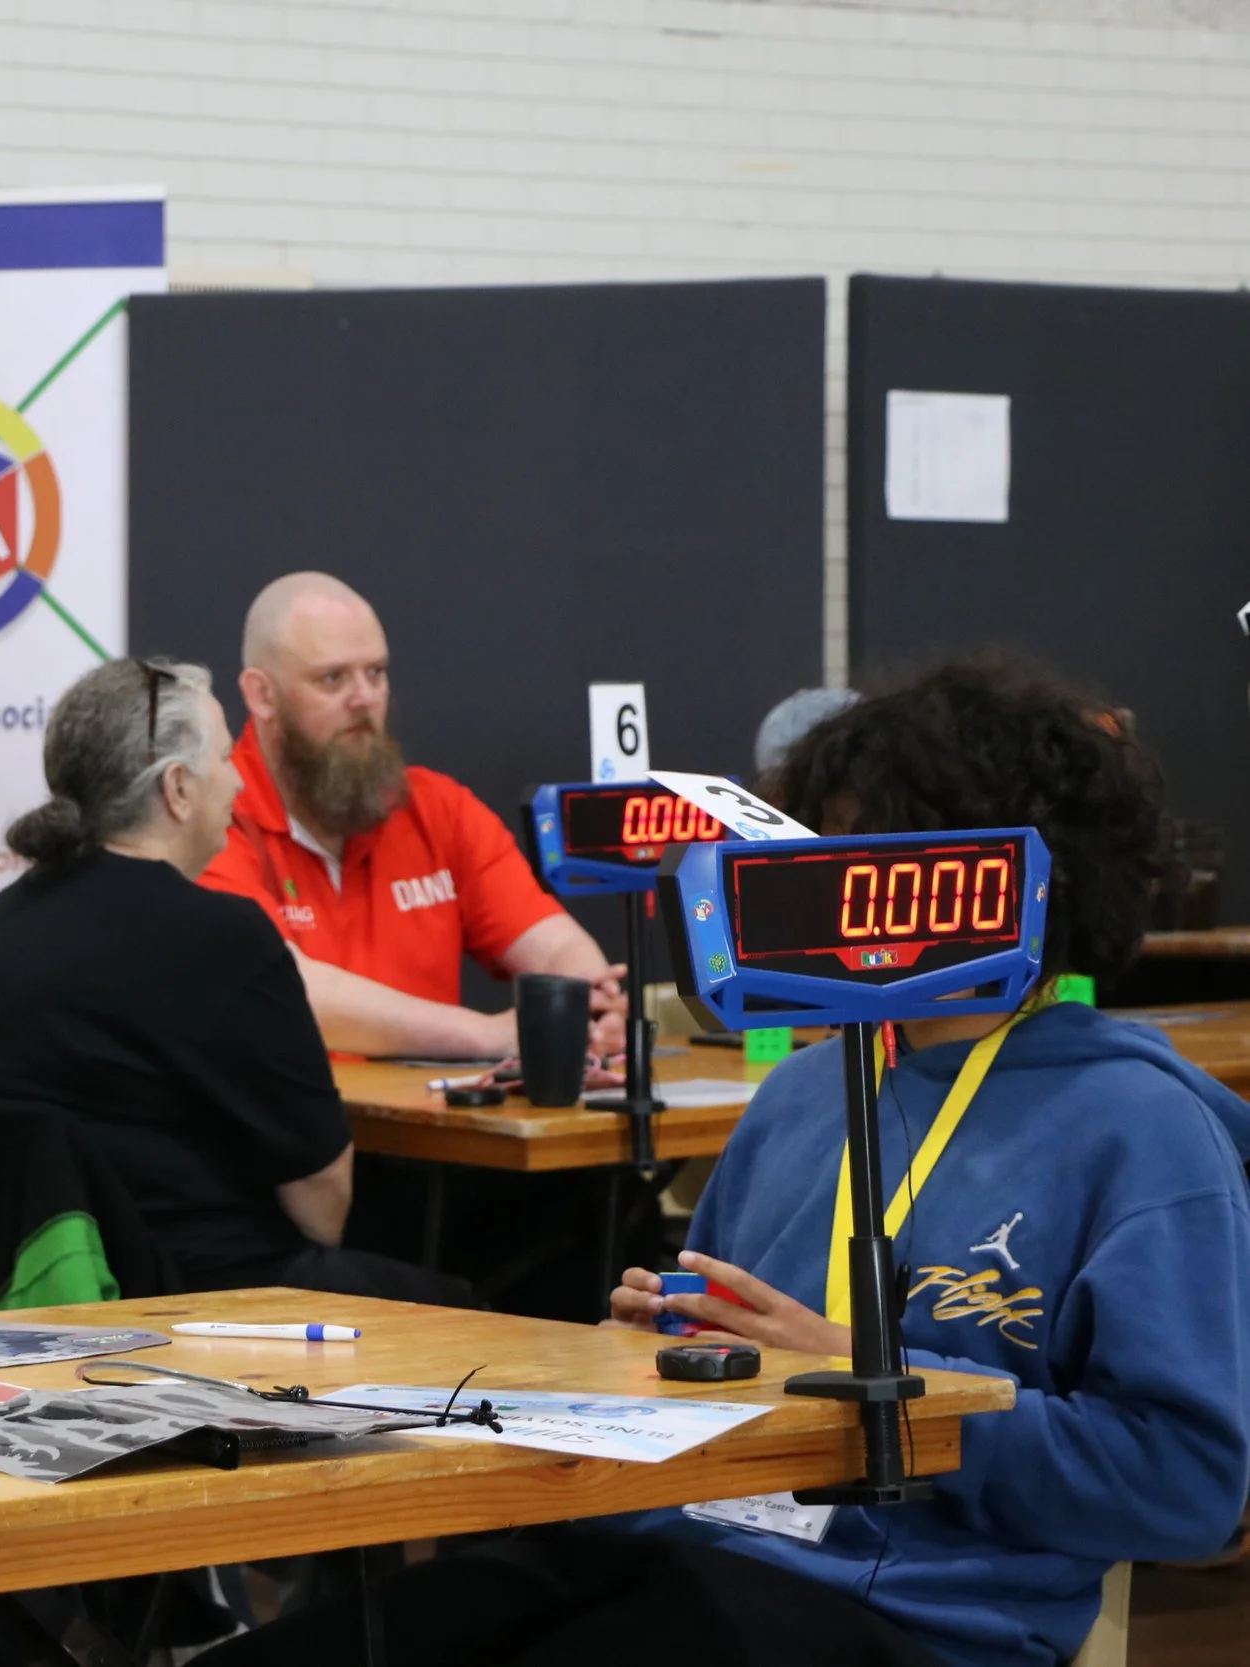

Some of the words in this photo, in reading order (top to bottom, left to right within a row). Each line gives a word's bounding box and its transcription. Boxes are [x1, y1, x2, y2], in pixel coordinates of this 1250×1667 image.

[616, 703, 640, 756] 6
[705, 785, 784, 826] 3
[841, 858, 1008, 938] 0.000
[595, 1424, 674, 1440] BLIND
[765, 1500, 795, 1513] Castro
